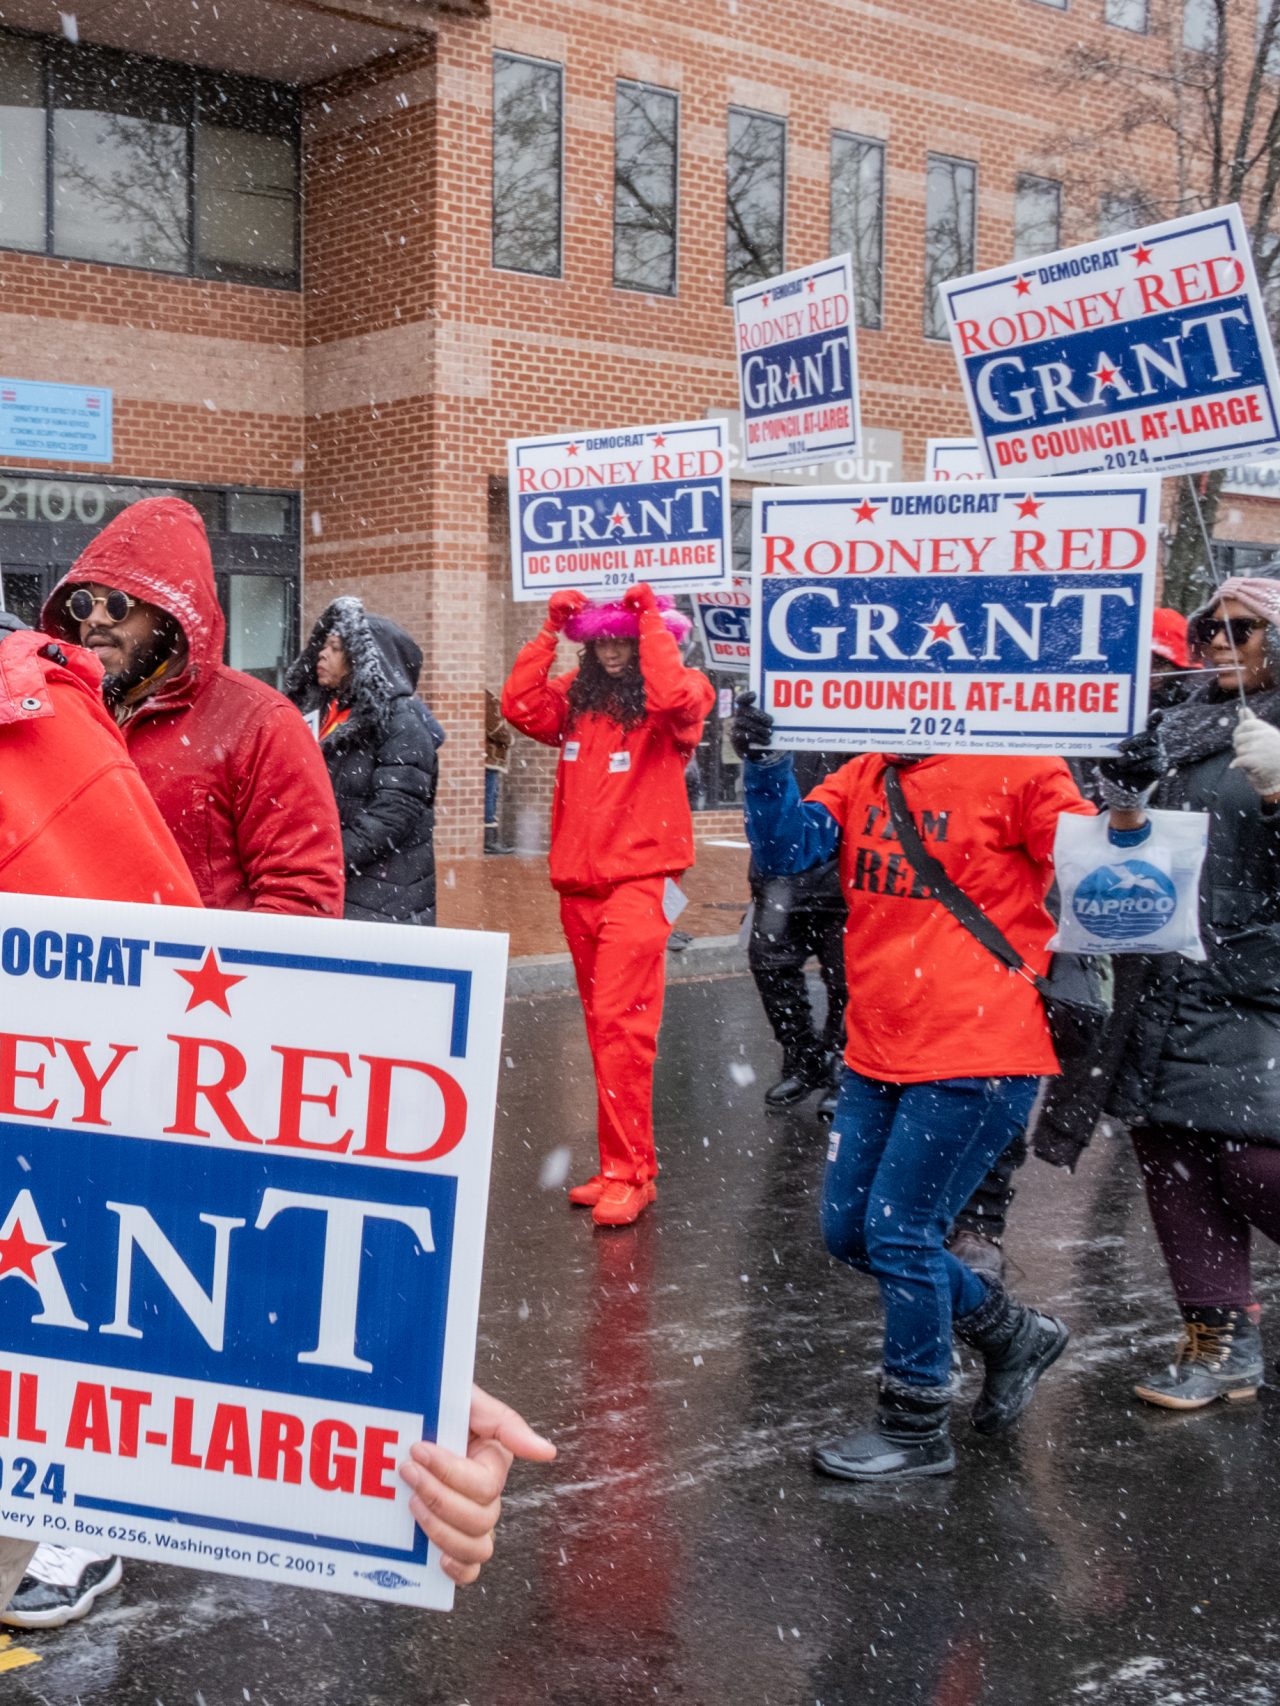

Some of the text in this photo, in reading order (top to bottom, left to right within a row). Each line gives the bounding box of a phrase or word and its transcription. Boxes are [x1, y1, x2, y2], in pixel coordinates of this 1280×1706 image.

[1038, 249, 1120, 285] DEMOCRAT
[773, 280, 803, 301] DEMOCRAT
[955, 256, 1245, 356] RODNEY RED
[739, 294, 849, 351] RODNEY RED
[744, 336, 848, 409] GRANT
[976, 308, 1250, 422] GRANT
[586, 434, 644, 451] DEMOCRAT
[748, 406, 849, 444] DC COUNCIL AT-LARGE
[995, 394, 1263, 466] DC COUNCIL AT-LARGE
[517, 460, 643, 493] RODNEY
[651, 449, 724, 481] RED
[835, 458, 893, 483] OUT
[1105, 449, 1150, 470] 2024
[523, 486, 720, 544] GRANT
[890, 493, 1000, 516] DEMOCRAT
[528, 544, 716, 575] DC COUNCIL AT-LARGE
[762, 527, 1147, 576] RODNEY RED
[604, 573, 635, 585] 2024
[697, 592, 751, 606] ROD
[767, 586, 1134, 662] GRANT
[714, 643, 733, 656] DC
[773, 680, 1119, 713] DC COUNCIL AT-LARGE
[910, 717, 966, 736] 2024
[862, 805, 952, 842] TM
[163, 1034, 467, 1162] RED
[65, 1381, 399, 1500] AT-LARGE
[43, 1515, 70, 1531] P.O.
[75, 1520, 103, 1536] Box
[108, 1526, 151, 1545] 6256.
[155, 1533, 251, 1562] Washington
[257, 1552, 280, 1567] DC
[284, 1556, 336, 1576] 20015
